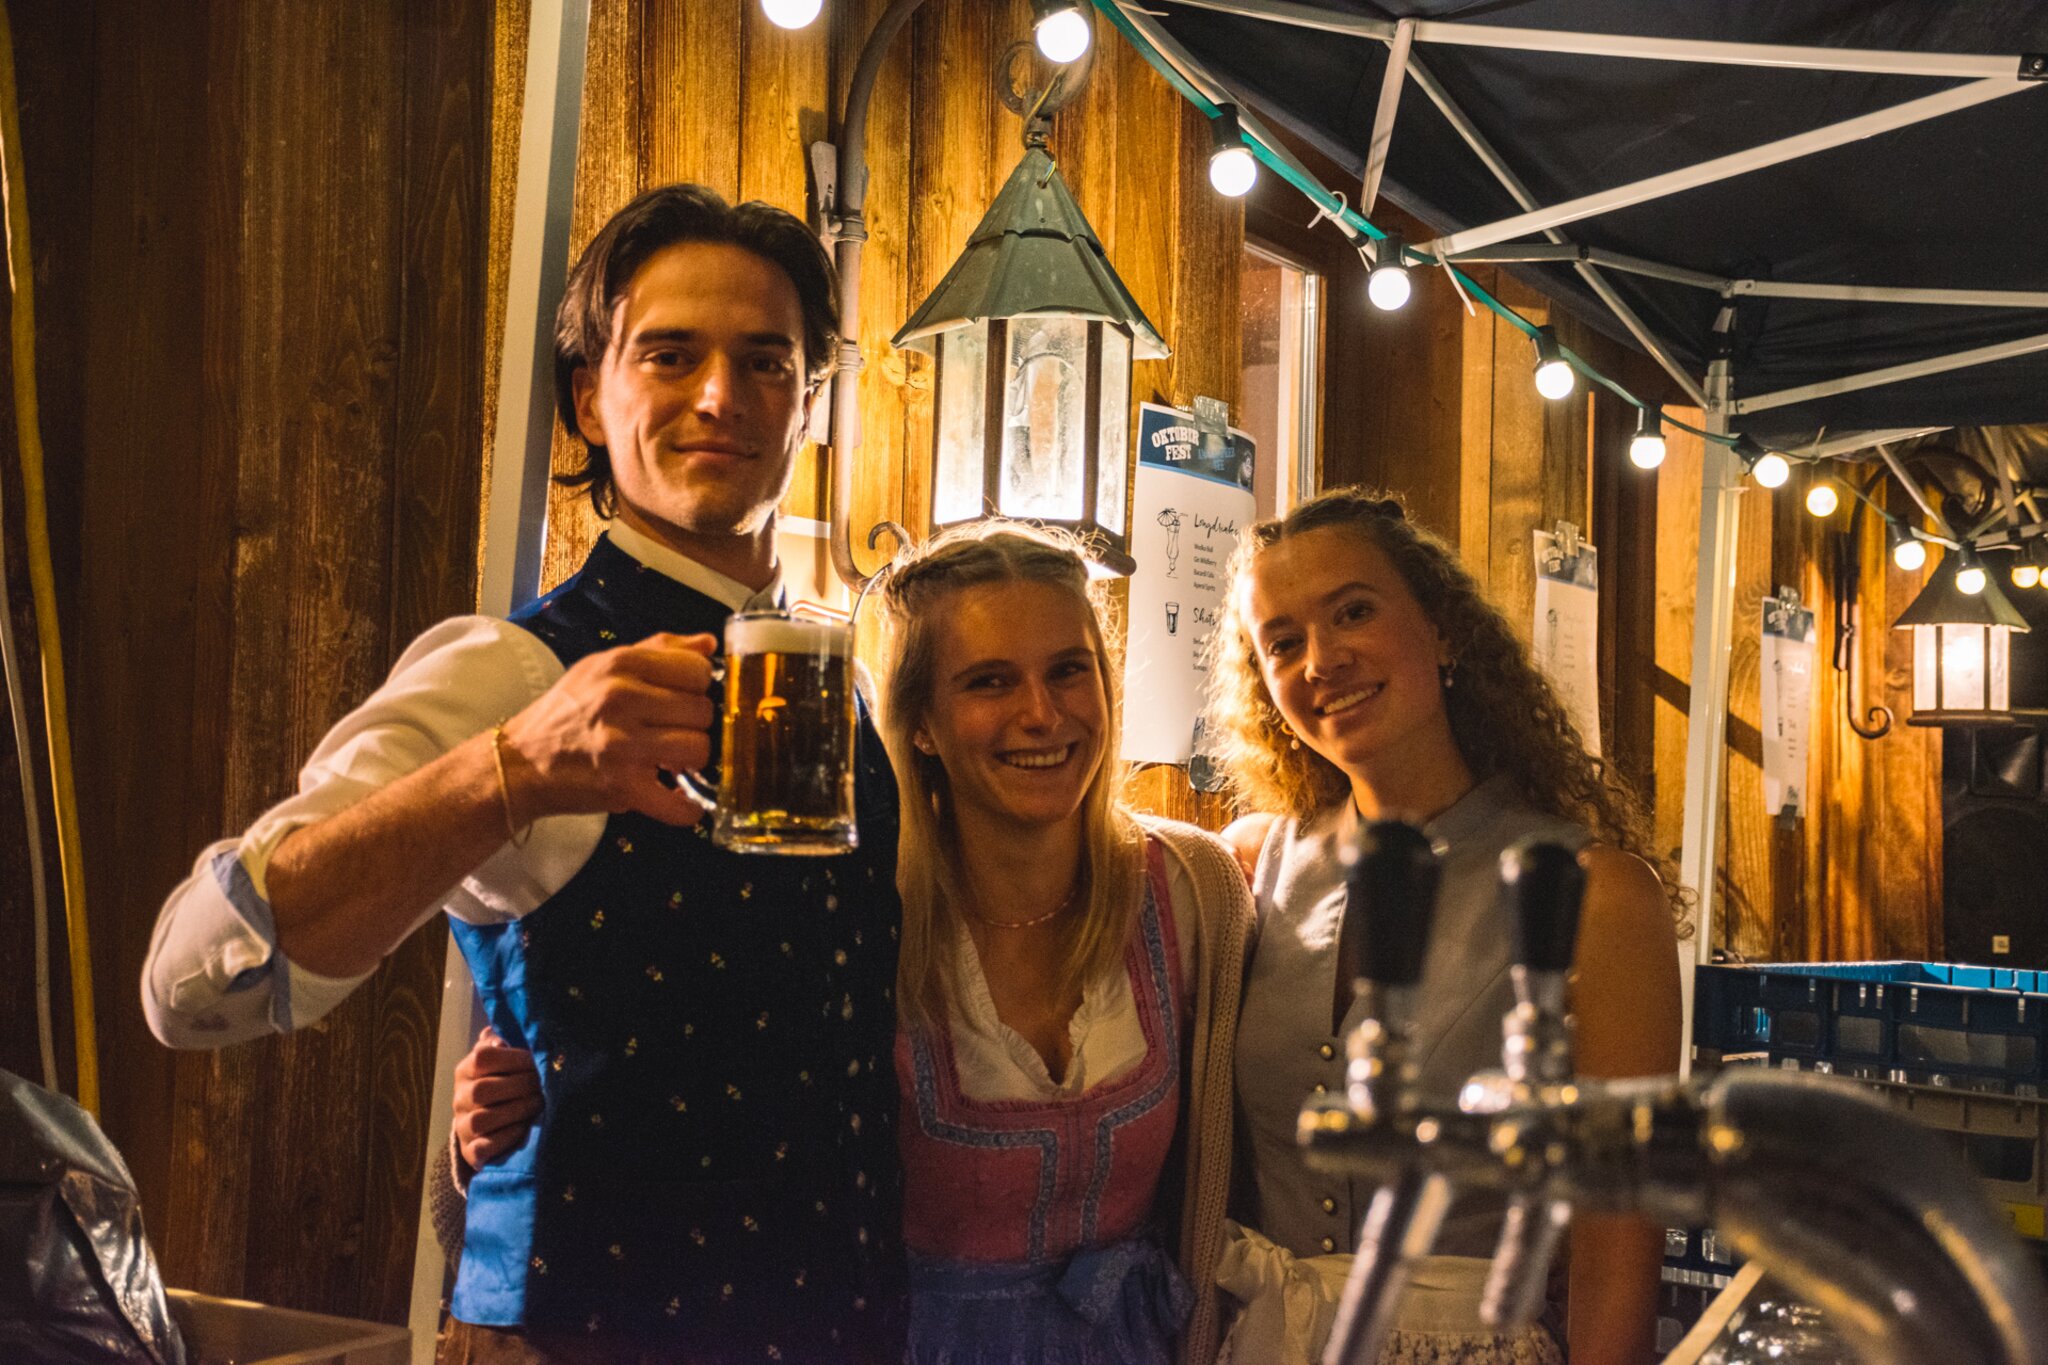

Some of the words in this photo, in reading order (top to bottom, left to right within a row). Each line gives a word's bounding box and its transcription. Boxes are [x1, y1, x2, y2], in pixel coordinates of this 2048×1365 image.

[1151, 426, 1200, 448] OKTOBER
[1164, 444, 1192, 461] FEST
[1193, 607, 1217, 626] Shots
